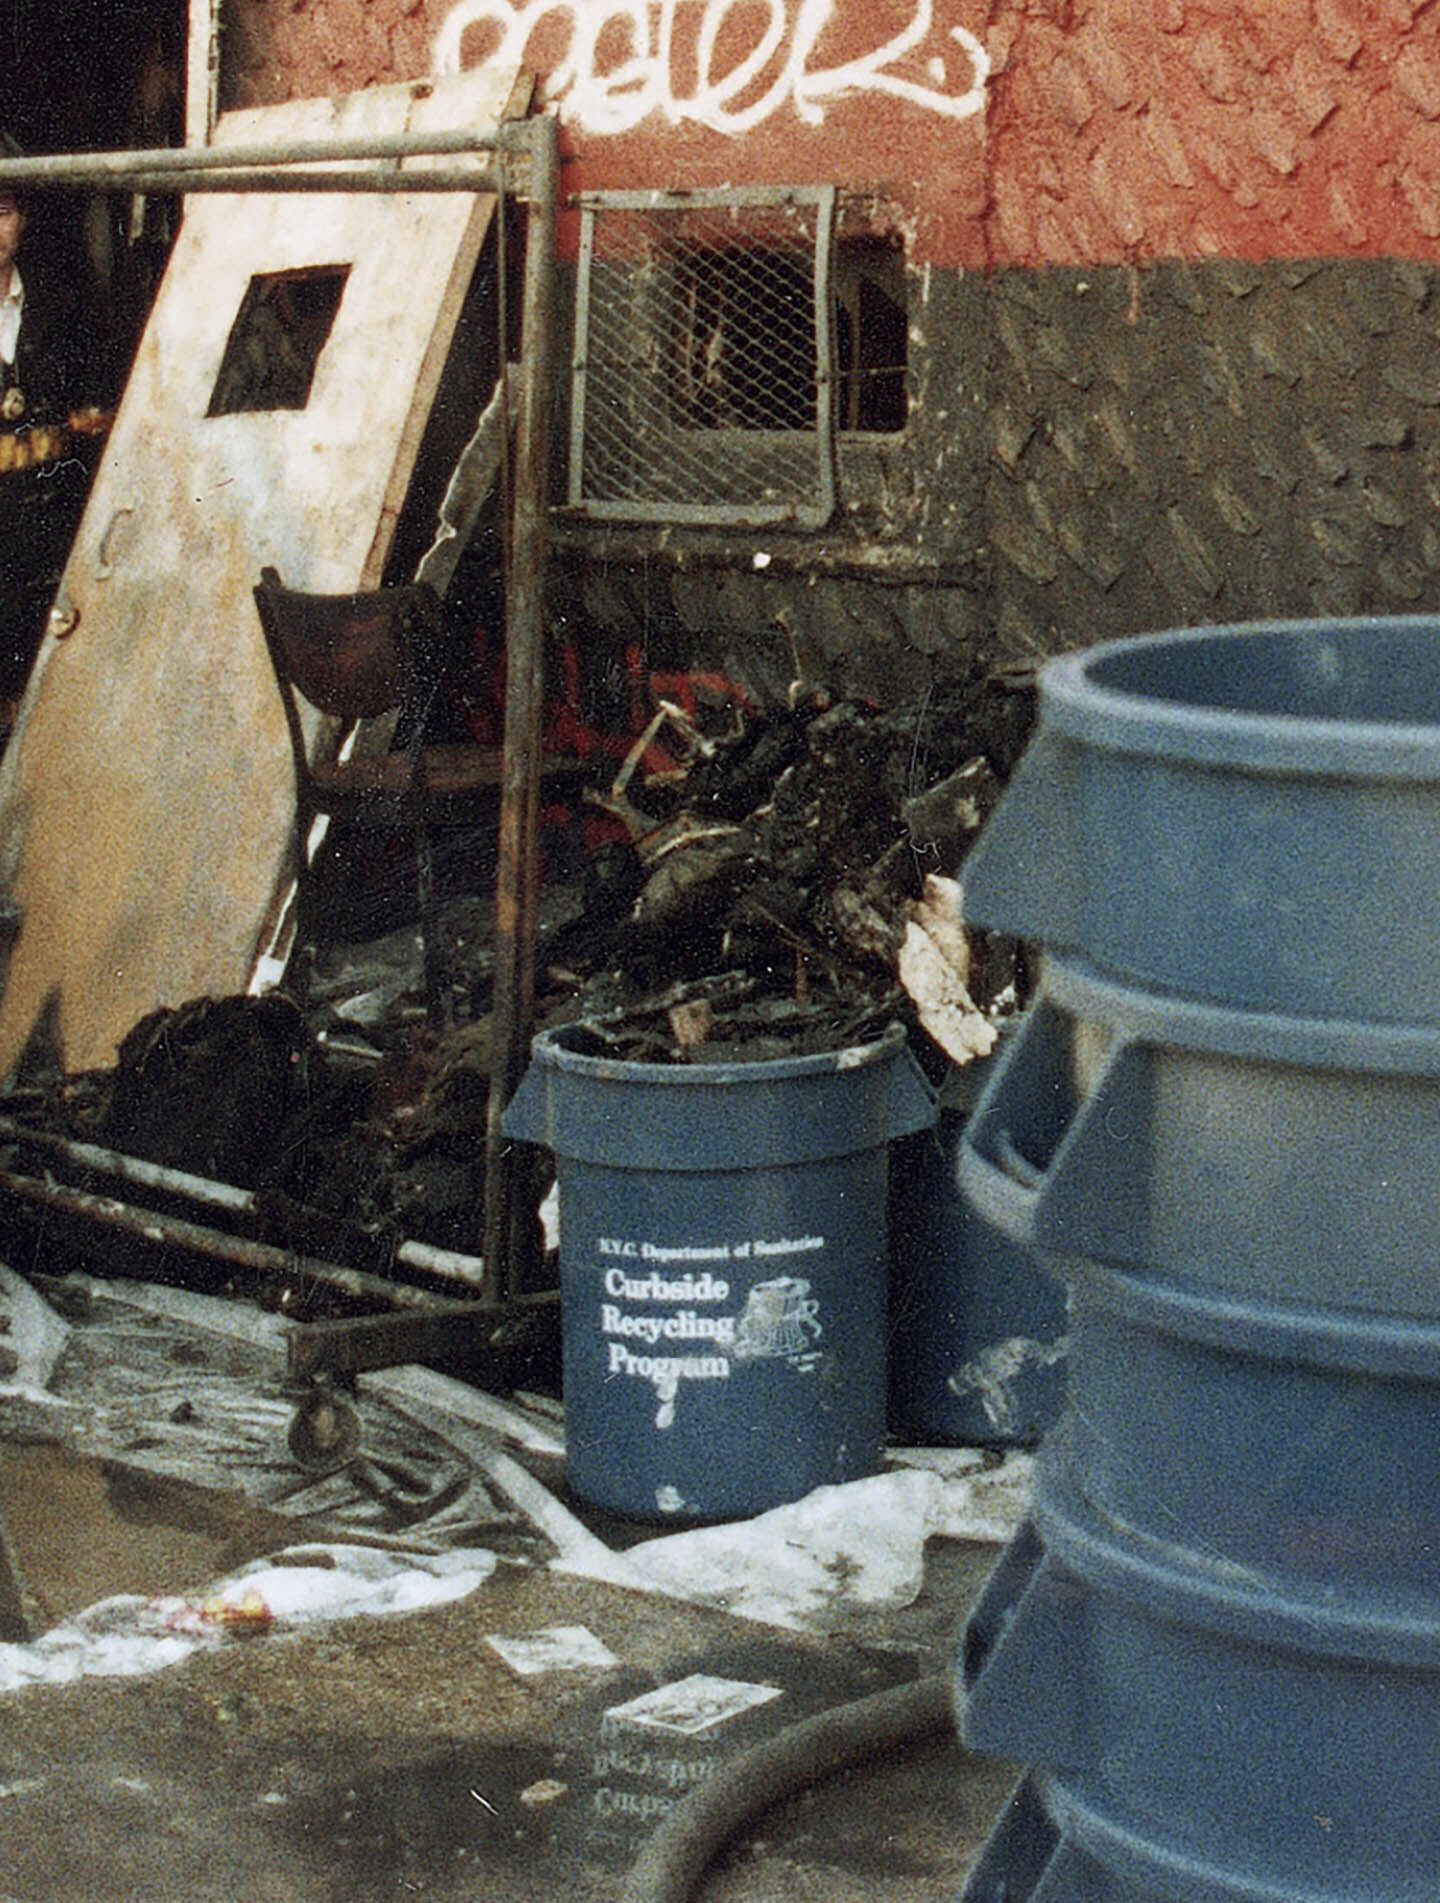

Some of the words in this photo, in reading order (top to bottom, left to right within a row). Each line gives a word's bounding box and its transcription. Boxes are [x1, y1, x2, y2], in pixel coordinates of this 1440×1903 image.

[605, 1267, 730, 1302] Curbside
[601, 1303, 737, 1345] Recycling
[607, 1342, 730, 1387] Program
